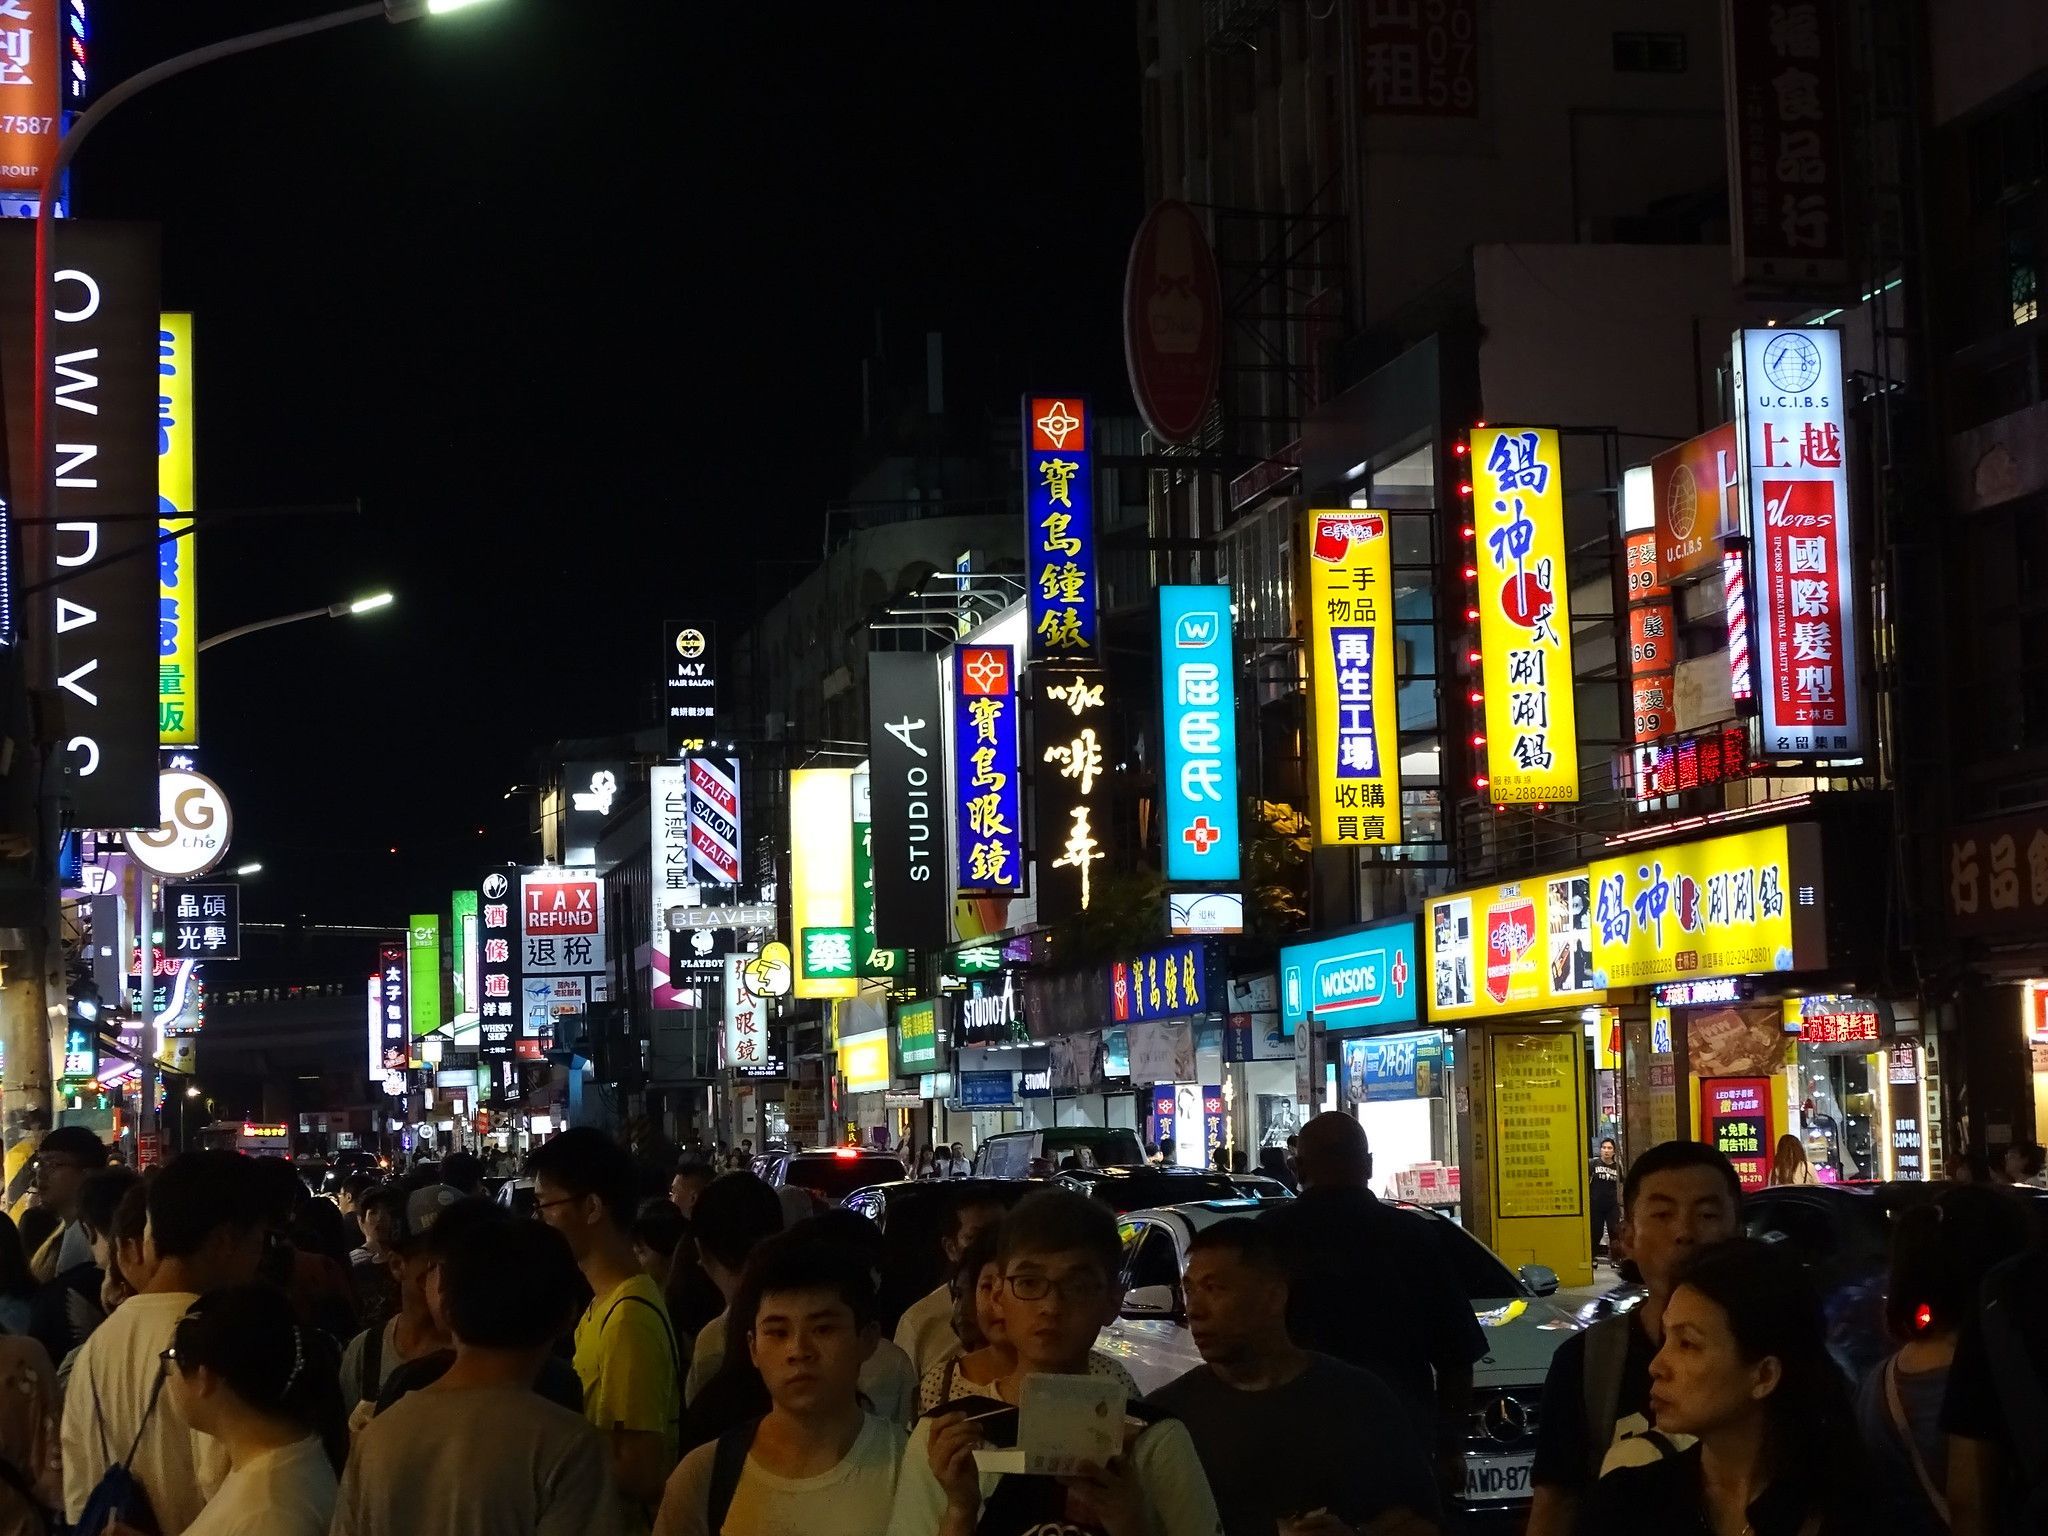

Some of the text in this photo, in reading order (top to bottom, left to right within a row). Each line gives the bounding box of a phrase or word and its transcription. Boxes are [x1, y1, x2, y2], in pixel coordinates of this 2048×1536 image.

[1759, 396, 1830, 408] U.C.I.B.S
[1752, 421, 1842, 469] 上越
[1328, 568, 1376, 592] 二手
[1328, 598, 1377, 623] 物品
[1787, 535, 1836, 704] 國際髮型
[678, 663, 706, 677] M.Y
[668, 679, 714, 687] HAIR SALON
[1337, 633, 1375, 772] 再生工場
[1795, 708, 1834, 722] 士林店
[1177, 662, 1222, 802] 屈臣氏
[694, 770, 732, 807] HAIR
[966, 697, 1013, 885] 寶島眼鏡
[1335, 784, 1386, 809] 收購
[1493, 785, 1574, 801] 02-28822289
[693, 800, 735, 841] SALON
[907, 766, 930, 882] STUDIO
[1337, 815, 1386, 842] 買賣
[696, 834, 733, 871] HAIR
[176, 893, 227, 919] 晶碩
[528, 889, 592, 911] TAX
[528, 910, 593, 928] REFUND
[671, 908, 771, 926] BEAVER
[176, 926, 227, 950] 光學
[483, 903, 510, 998] 酒條通
[527, 936, 593, 967] 退稅
[680, 959, 725, 968] PLAYBOY
[1321, 965, 1376, 998] watsons
[482, 1002, 512, 1017] 洋酒
[963, 994, 1000, 1029] STUDIO
[481, 1024, 514, 1033] WHISKY
[487, 1032, 508, 1041] SHOP
[1728, 1122, 1748, 1137] 免費
